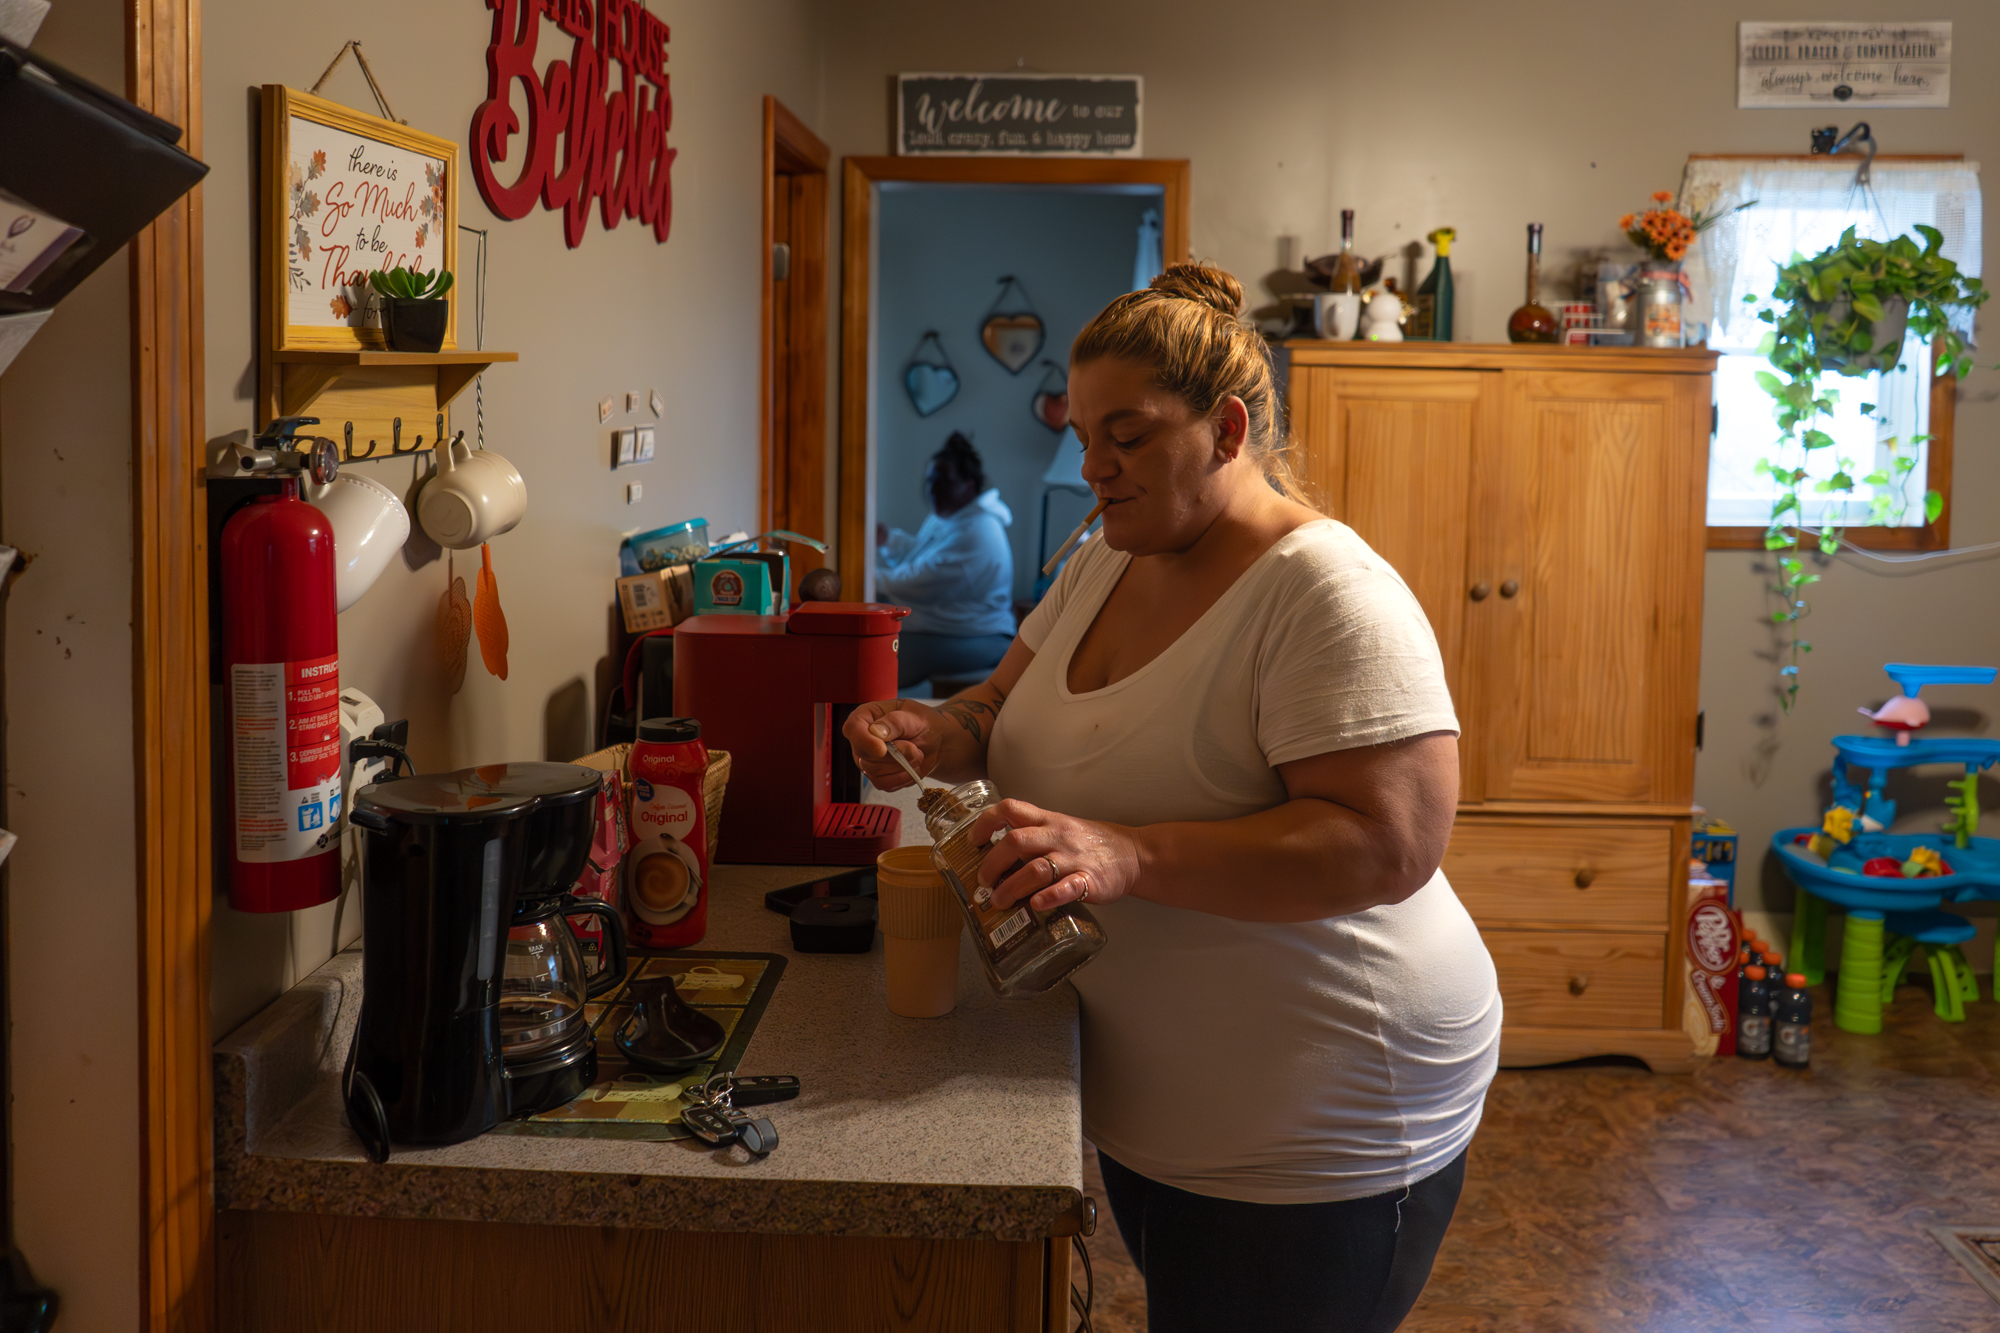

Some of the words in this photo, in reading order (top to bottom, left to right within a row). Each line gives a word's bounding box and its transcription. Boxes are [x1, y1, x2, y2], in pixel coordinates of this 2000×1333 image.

[1072, 104, 1090, 118] to
[1094, 104, 1124, 118] our
[348, 145, 385, 178] there
[387, 160, 398, 182] is
[321, 181, 355, 238] So
[354, 181, 418, 224] Much
[356, 227, 369, 252] to
[371, 225, 388, 253] be
[288, 691, 297, 701] 1.
[289, 719, 297, 730] 2.
[290, 751, 299, 763] 3.
[642, 754, 675, 765] Original
[641, 810, 688, 826] Original
[528, 943, 544, 952] MAX
